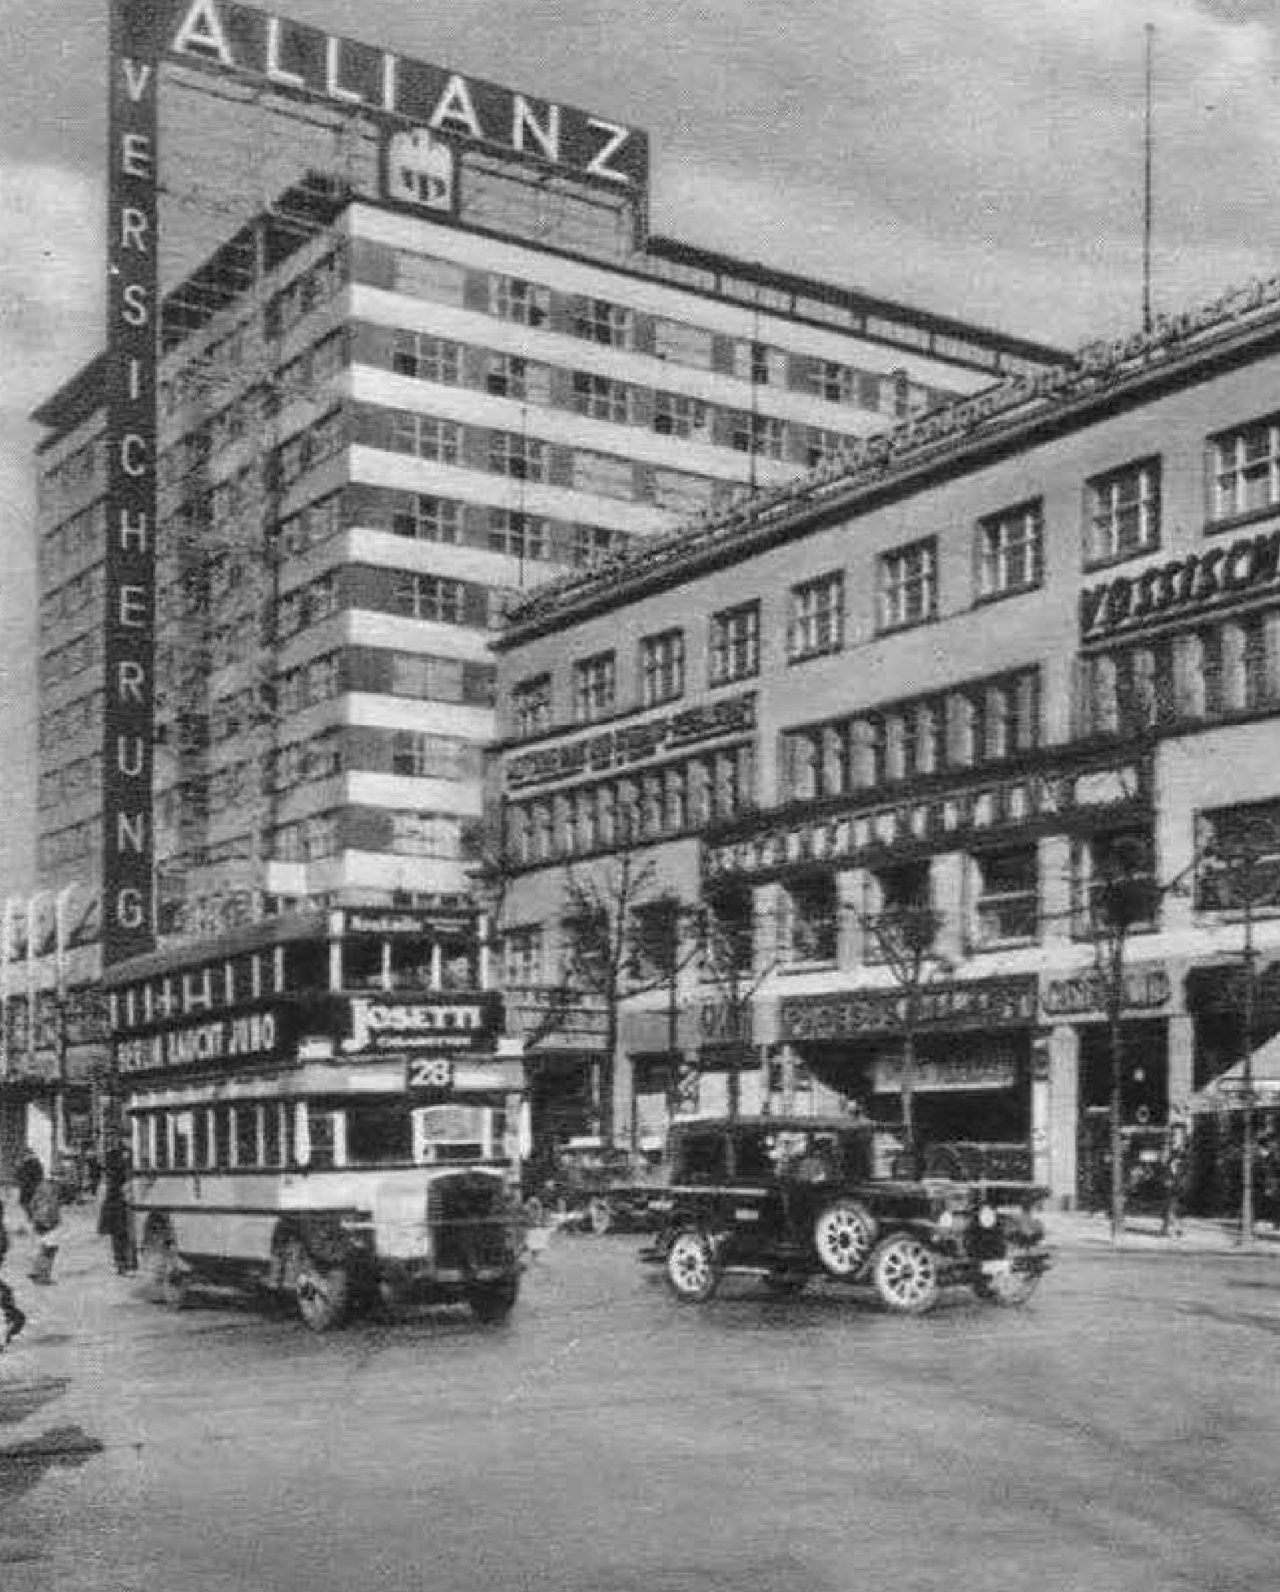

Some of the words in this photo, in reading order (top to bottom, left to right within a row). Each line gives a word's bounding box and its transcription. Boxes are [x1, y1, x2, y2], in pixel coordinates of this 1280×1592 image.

[173, 0, 630, 182] ALLIANZ
[118, 58, 149, 929] VERSICHERUNG
[410, 1057, 451, 1087] 28
